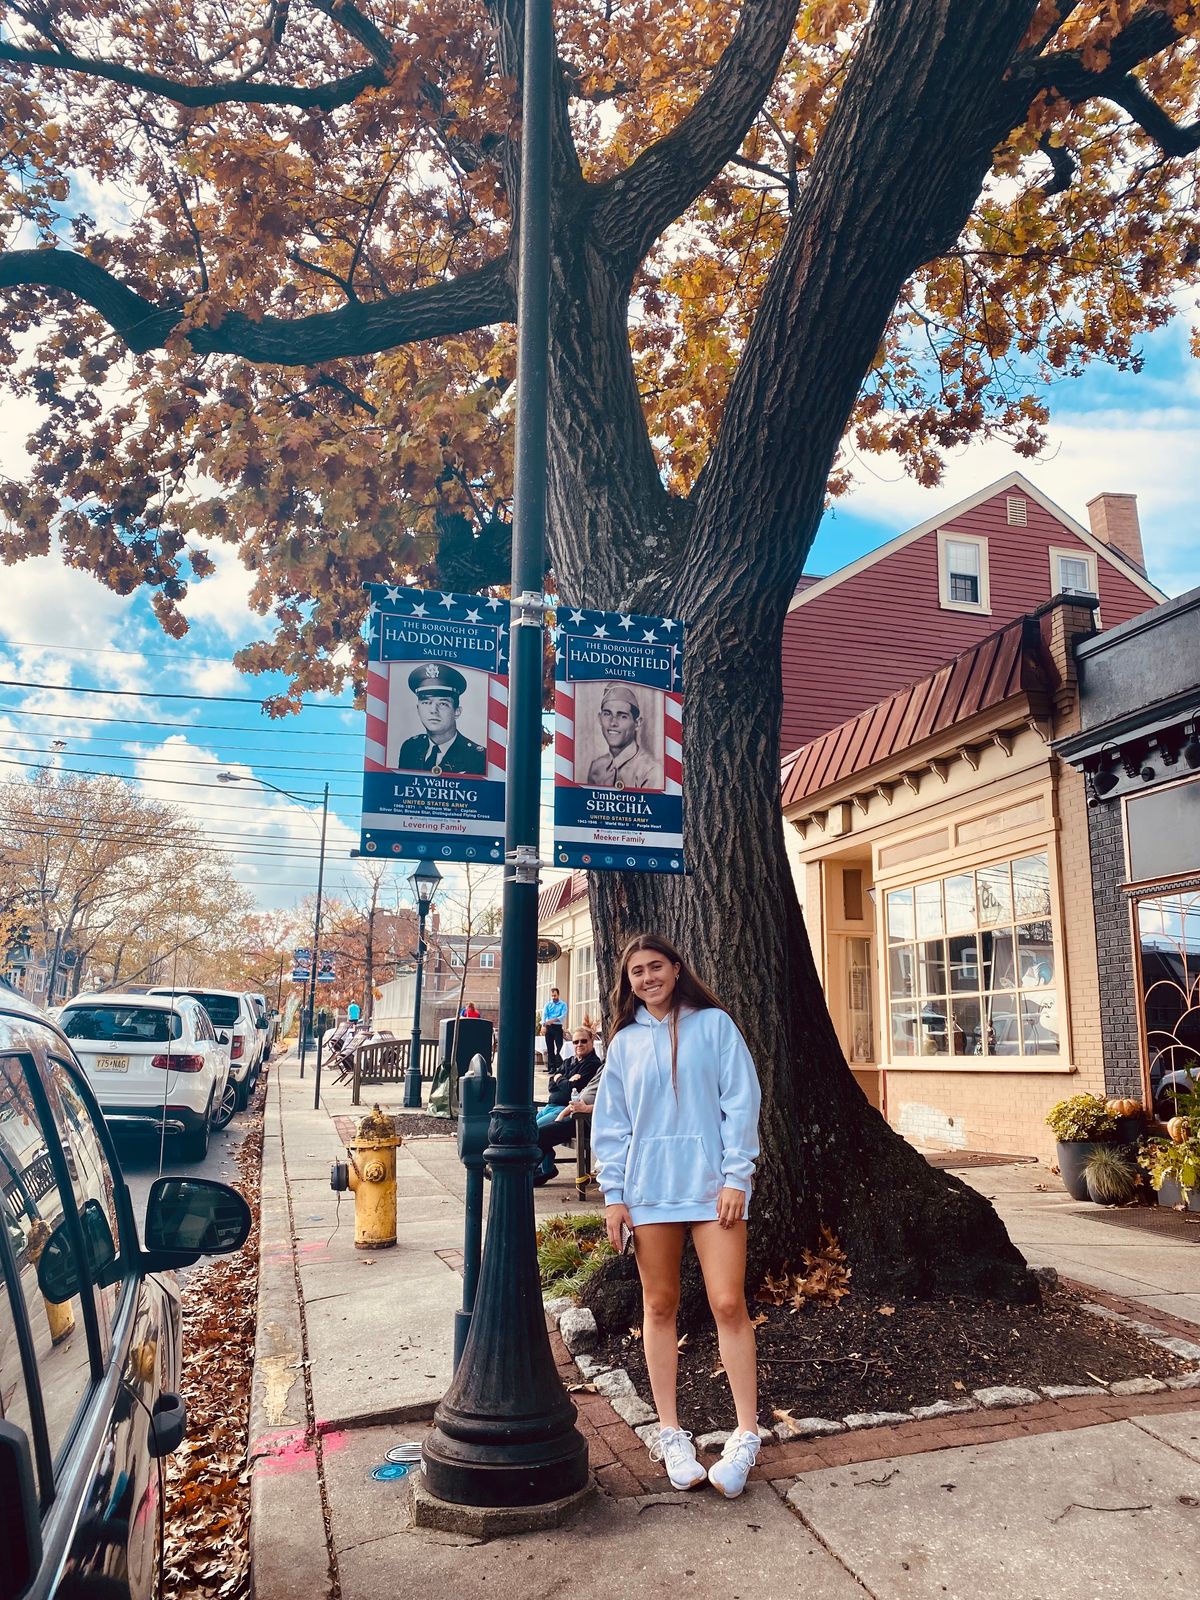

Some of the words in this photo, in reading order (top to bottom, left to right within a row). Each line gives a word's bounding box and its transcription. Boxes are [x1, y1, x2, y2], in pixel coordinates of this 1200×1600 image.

[402, 620, 420, 630] THE
[422, 622, 465, 634] BOROUGH
[468, 628, 479, 636] OF
[386, 628, 495, 652] HADDONFIELD
[423, 648, 458, 658] SALUTES
[586, 642, 601, 650] THE
[603, 644, 643, 654] BOROUGH
[570, 650, 670, 670] HADDONFIELD
[604, 668, 636, 678] SALUTES
[412, 778, 420, 786] J.
[424, 778, 460, 788] Walter
[393, 785, 478, 802] LEVERING
[592, 792, 636, 802] Umberto
[638, 794, 646, 803] J.
[586, 800, 652, 814] SERCHIA
[403, 820, 438, 831] Levering
[440, 823, 467, 832] Family
[593, 833, 620, 842] Meeker
[621, 835, 646, 844] Family
